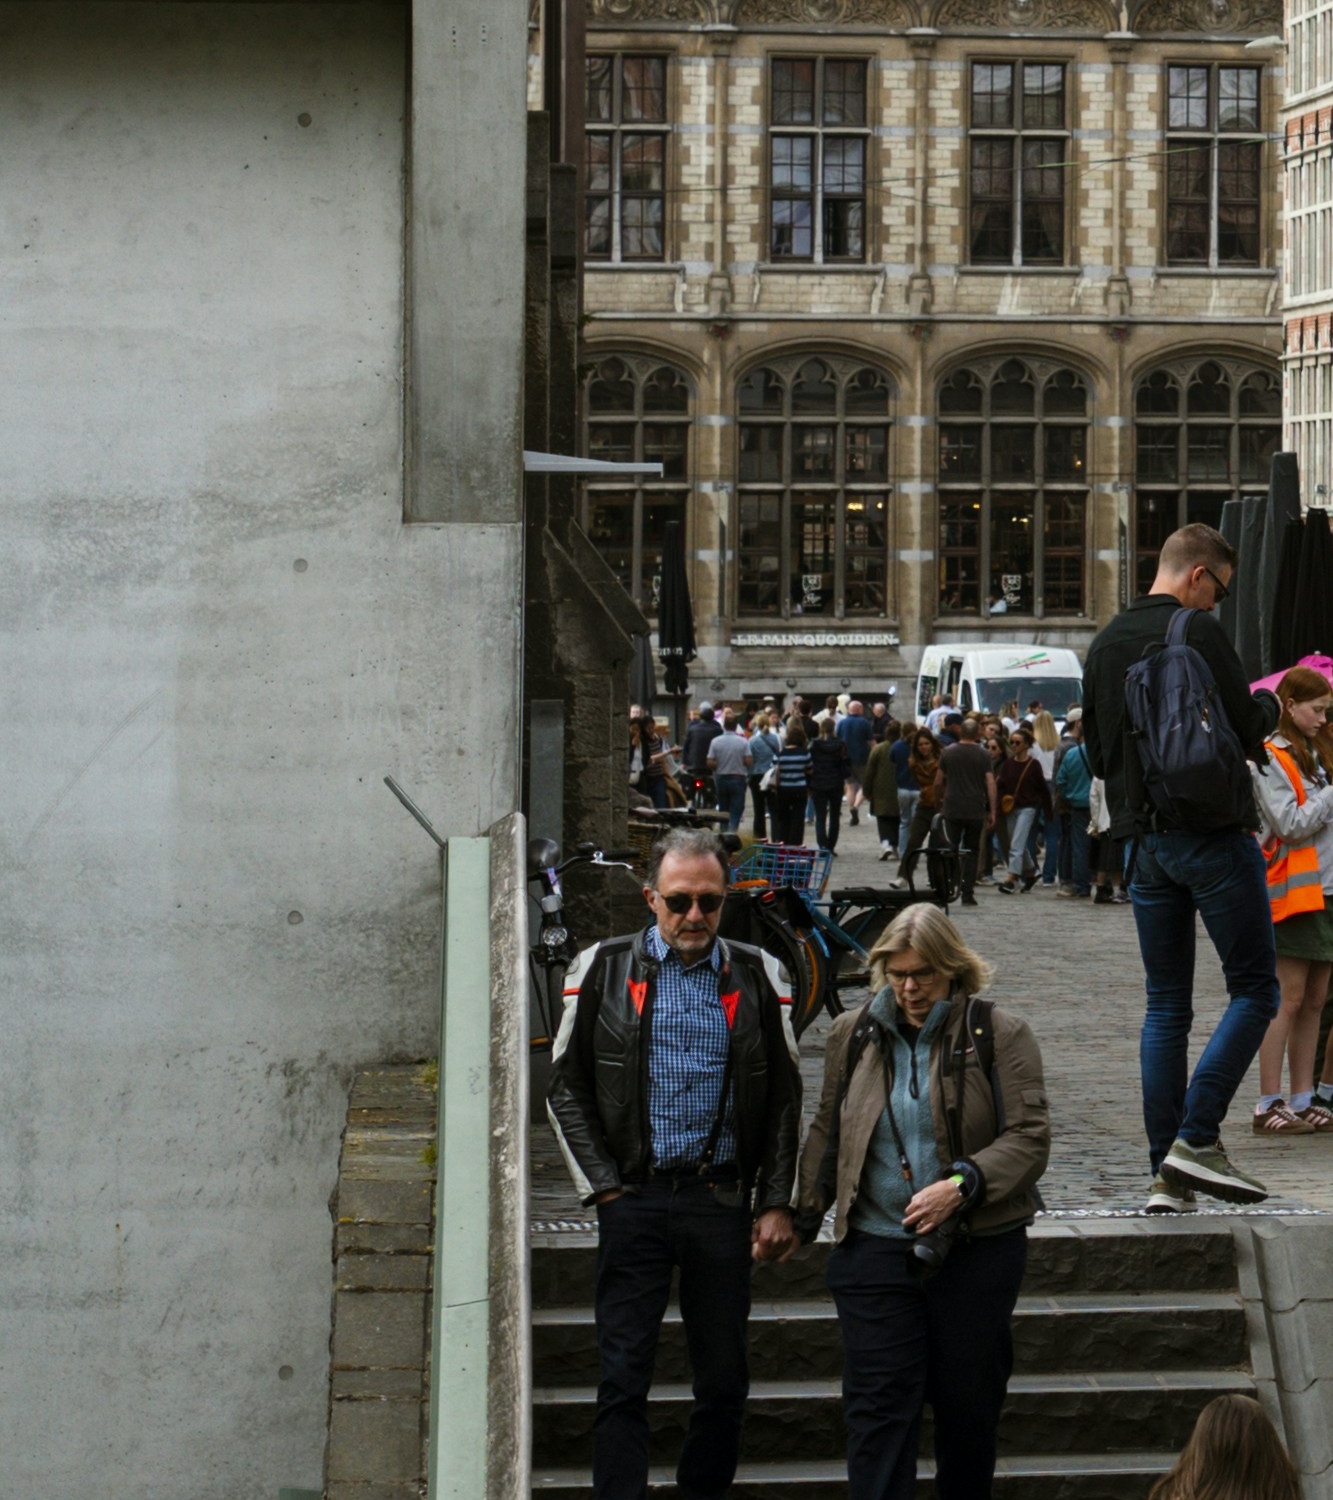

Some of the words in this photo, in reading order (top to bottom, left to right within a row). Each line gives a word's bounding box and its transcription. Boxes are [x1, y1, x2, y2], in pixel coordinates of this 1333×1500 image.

[736, 633, 758, 646] LE
[762, 633, 799, 646] PAIN
[803, 633, 895, 647] QUOTIDIEN
